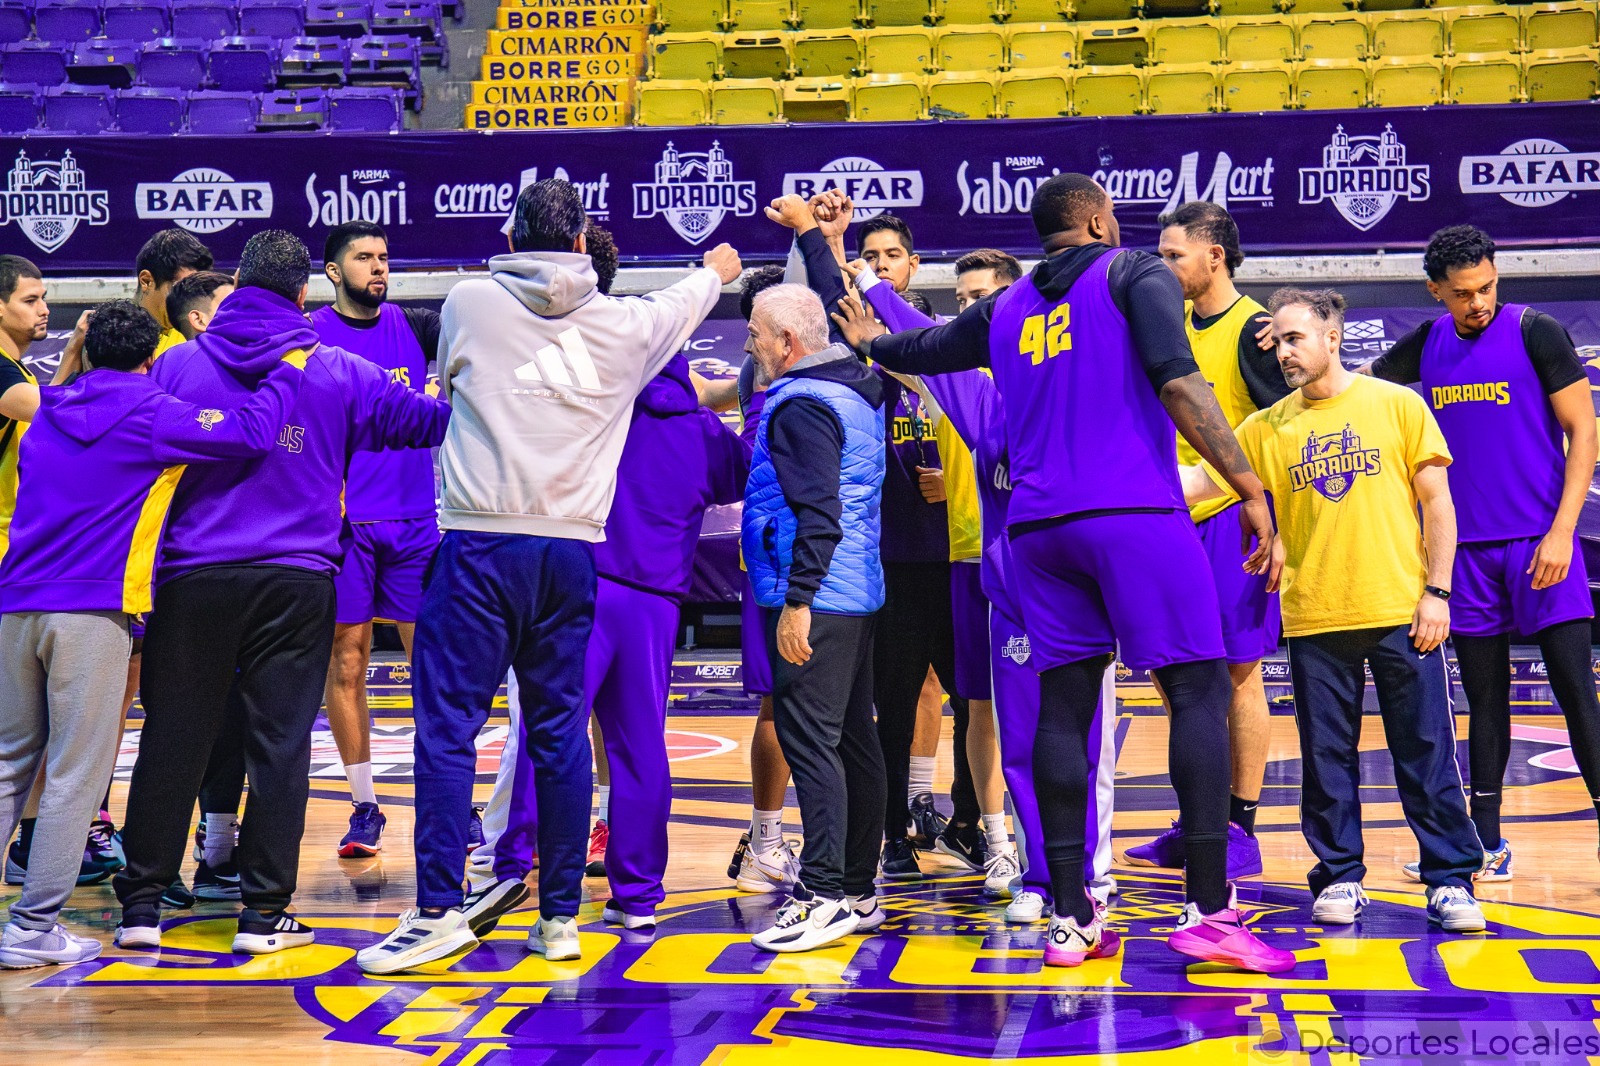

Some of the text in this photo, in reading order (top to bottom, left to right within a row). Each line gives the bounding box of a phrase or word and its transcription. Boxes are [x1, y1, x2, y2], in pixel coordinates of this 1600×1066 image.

[501, 32, 631, 55] CIMARRÓN
[484, 80, 618, 104] CIMARRÓN
[353, 169, 390, 180] PARMA
[1005, 156, 1045, 167] PARMA
[1471, 159, 1600, 186] BAFAR
[957, 160, 1061, 216] Sabo
[1301, 167, 1429, 203] DORADOS
[146, 188, 264, 212] BAFAR
[305, 172, 407, 228] Sabori
[635, 182, 754, 217] DORADOS
[1019, 302, 1073, 366] 42
[1432, 382, 1510, 410] DORADOS
[1289, 449, 1381, 492] DORADOS
[695, 665, 740, 676] MEXBET
[1261, 664, 1290, 675] EXBET
